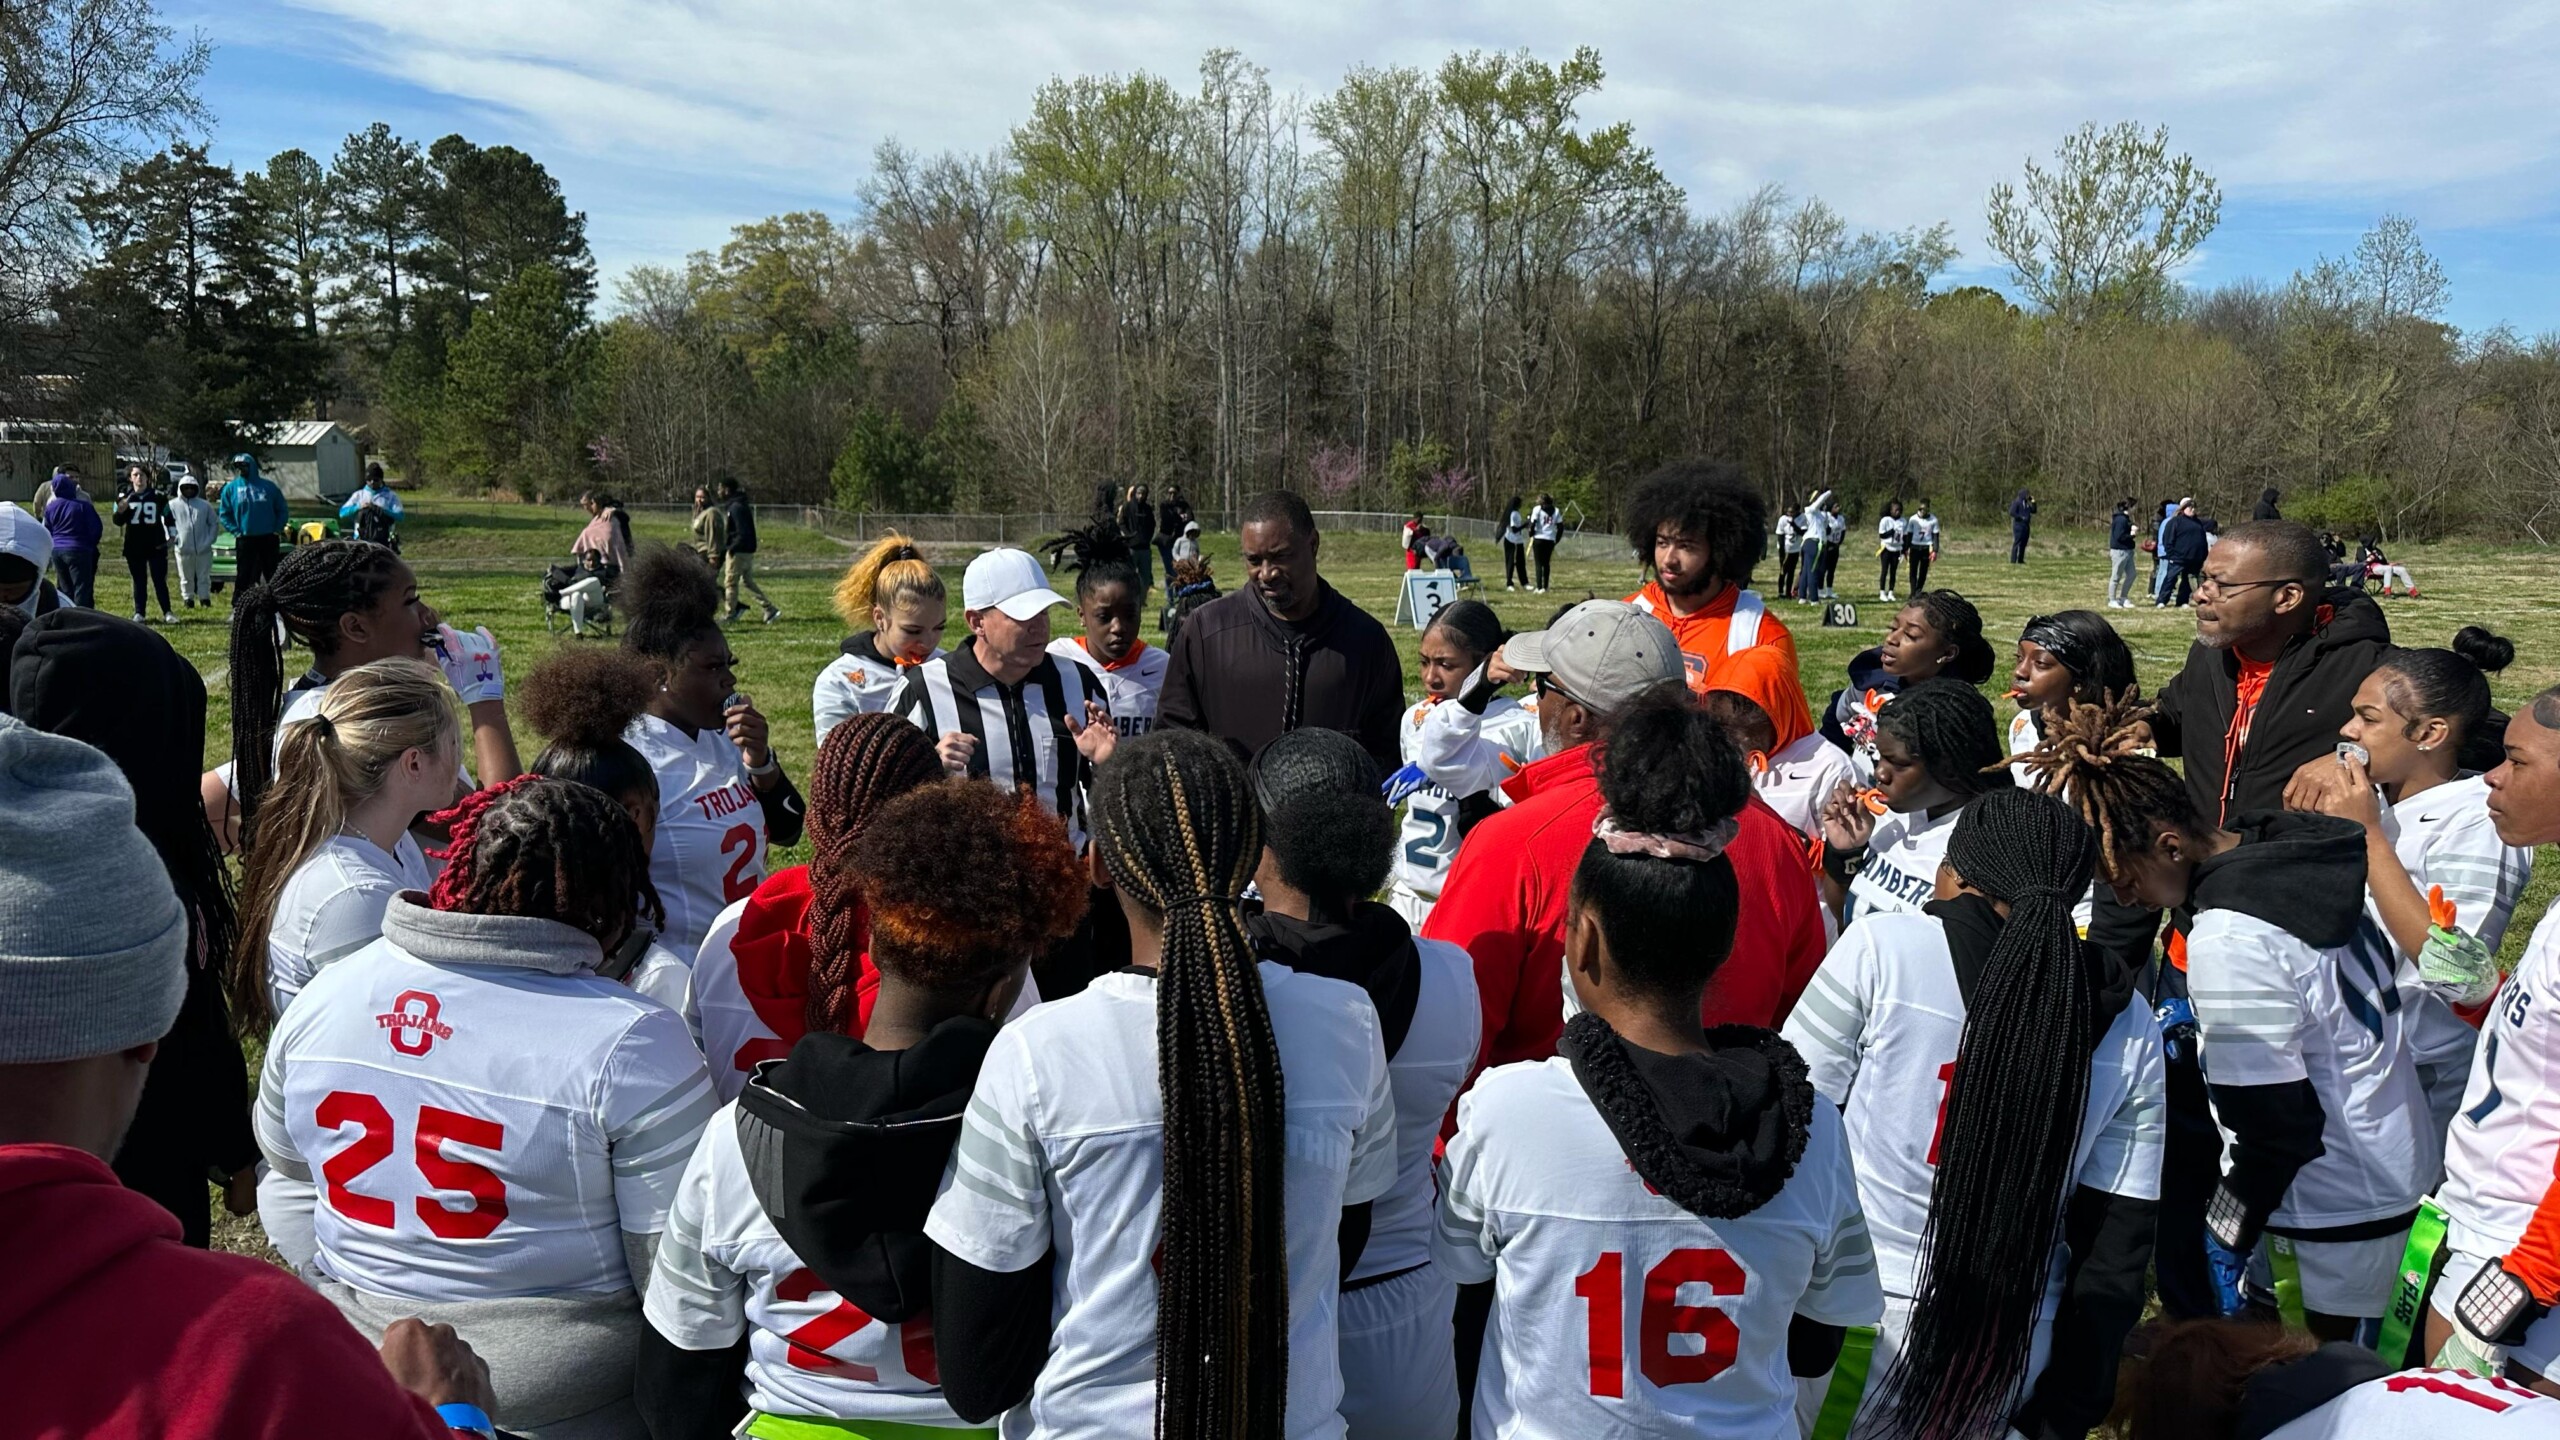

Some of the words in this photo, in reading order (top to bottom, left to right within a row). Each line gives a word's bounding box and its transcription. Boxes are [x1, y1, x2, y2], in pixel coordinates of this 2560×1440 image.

[129, 501, 157, 524] 79
[1426, 593, 1442, 617] 3
[1833, 603, 1856, 625] 30
[694, 783, 758, 820] TROJA
[1405, 808, 1446, 869] 2
[1862, 849, 1936, 907] AMBER
[375, 1012, 455, 1041] TROJANS
[315, 1091, 509, 1239] 25
[774, 1267, 943, 1386] 2
[1575, 1248, 1747, 1400] 16
